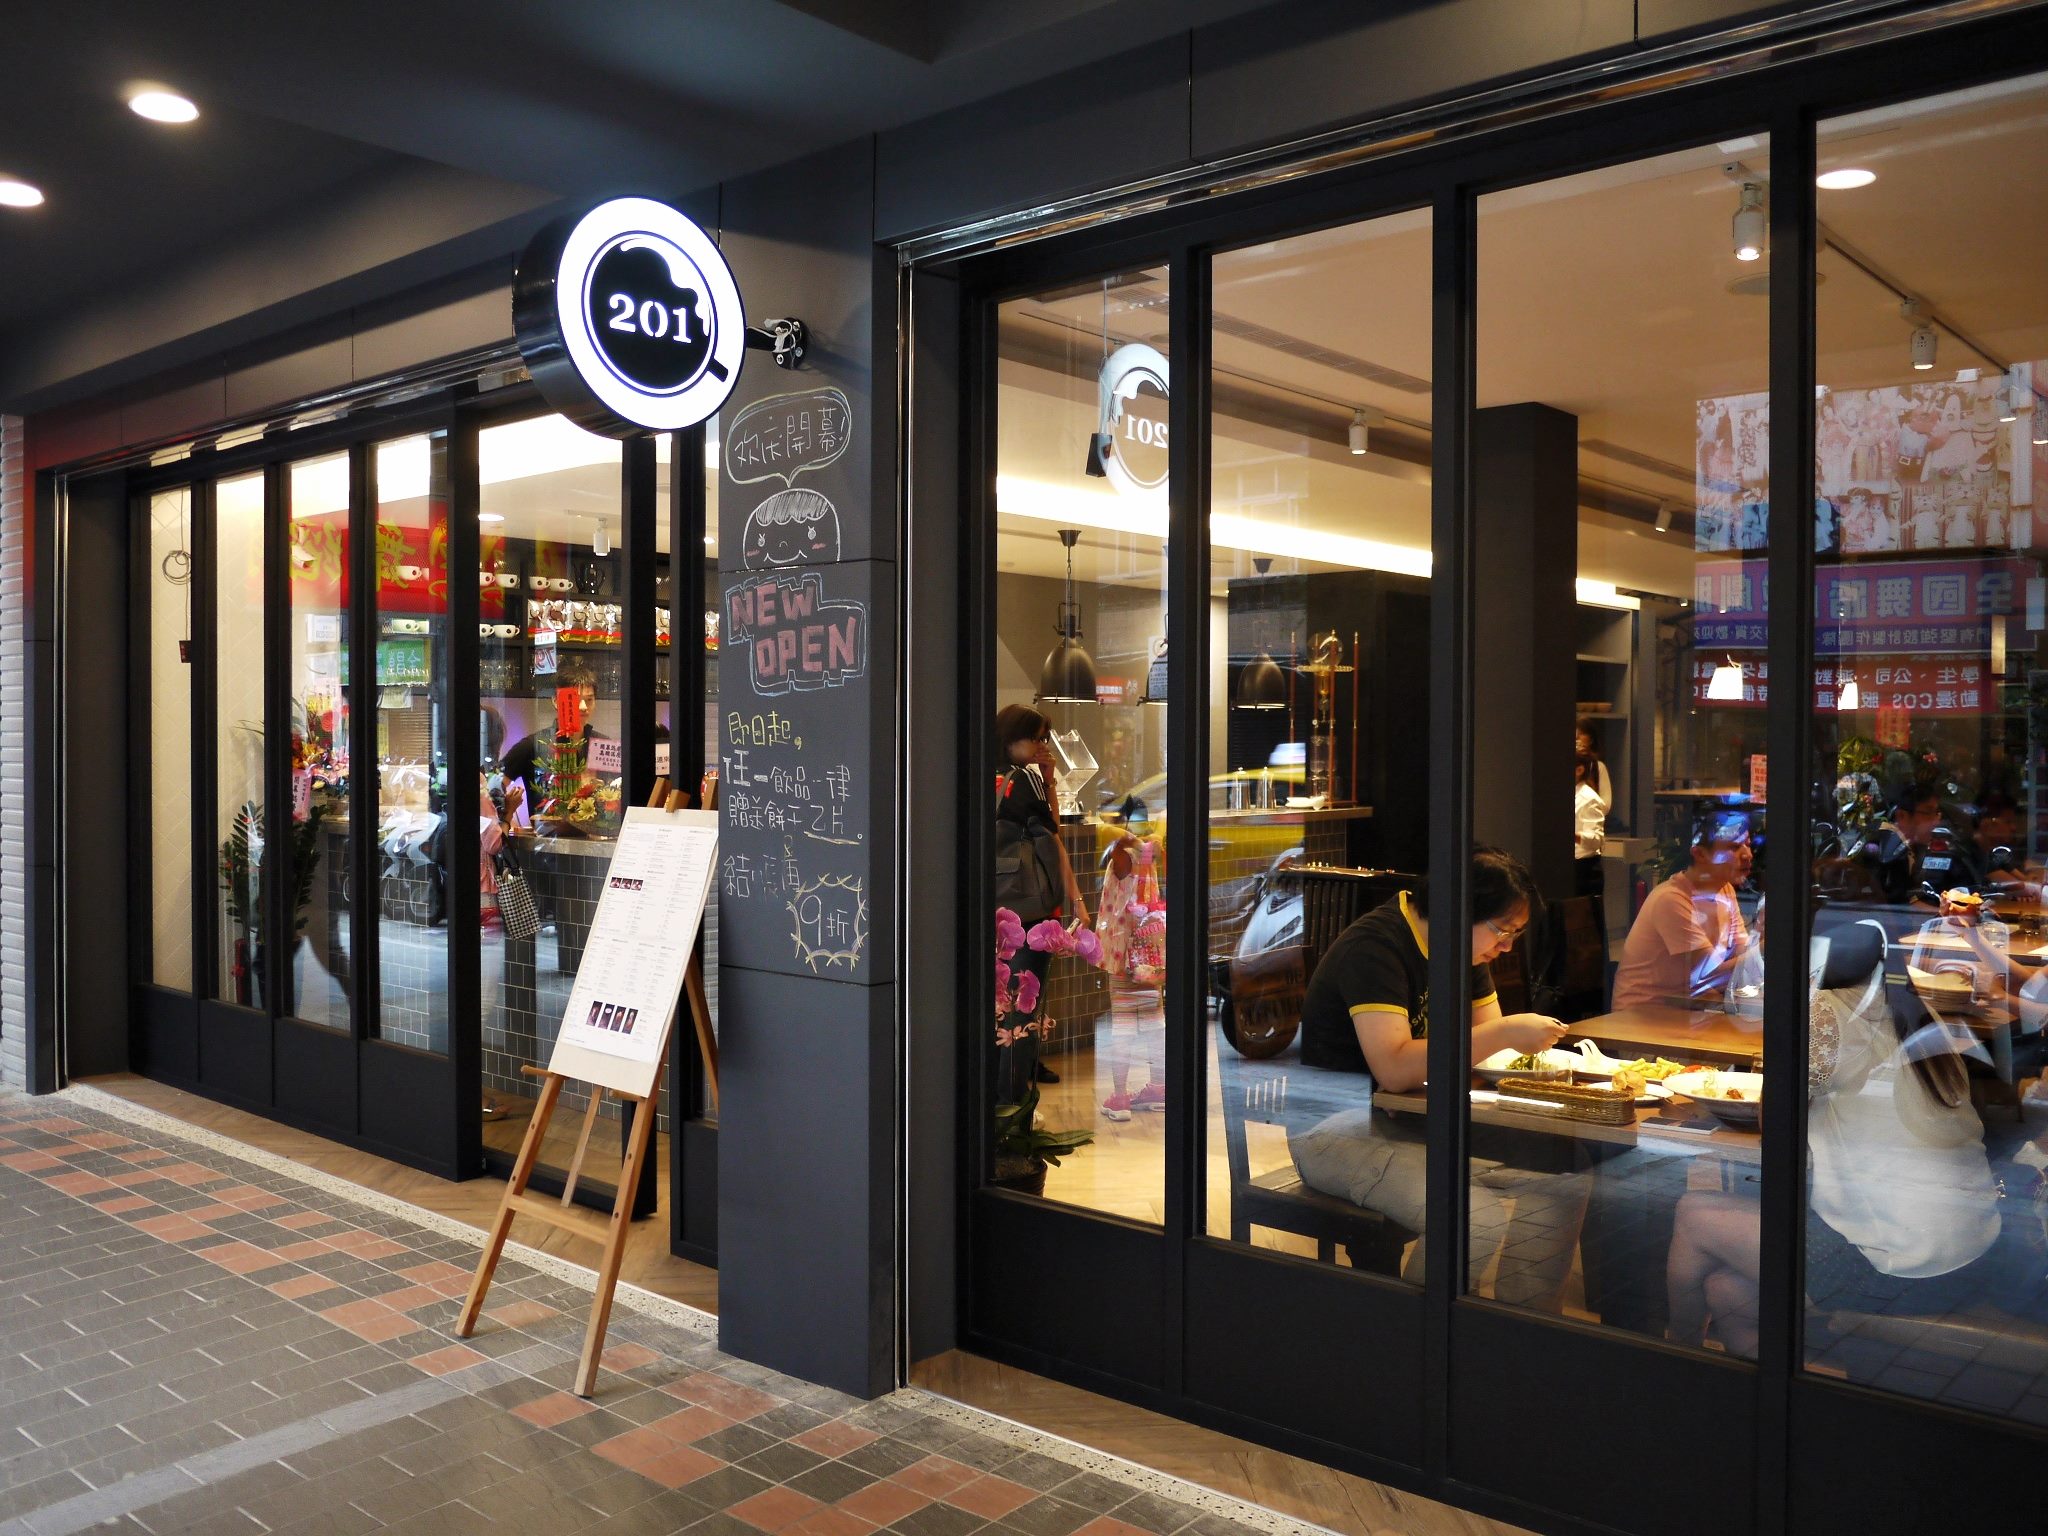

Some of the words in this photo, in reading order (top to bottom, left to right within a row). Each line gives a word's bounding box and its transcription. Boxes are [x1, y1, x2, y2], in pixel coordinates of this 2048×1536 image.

[608, 293, 692, 344] 201
[731, 583, 817, 631] NEW
[756, 616, 857, 678] OPEN
[800, 894, 850, 946] 9折
